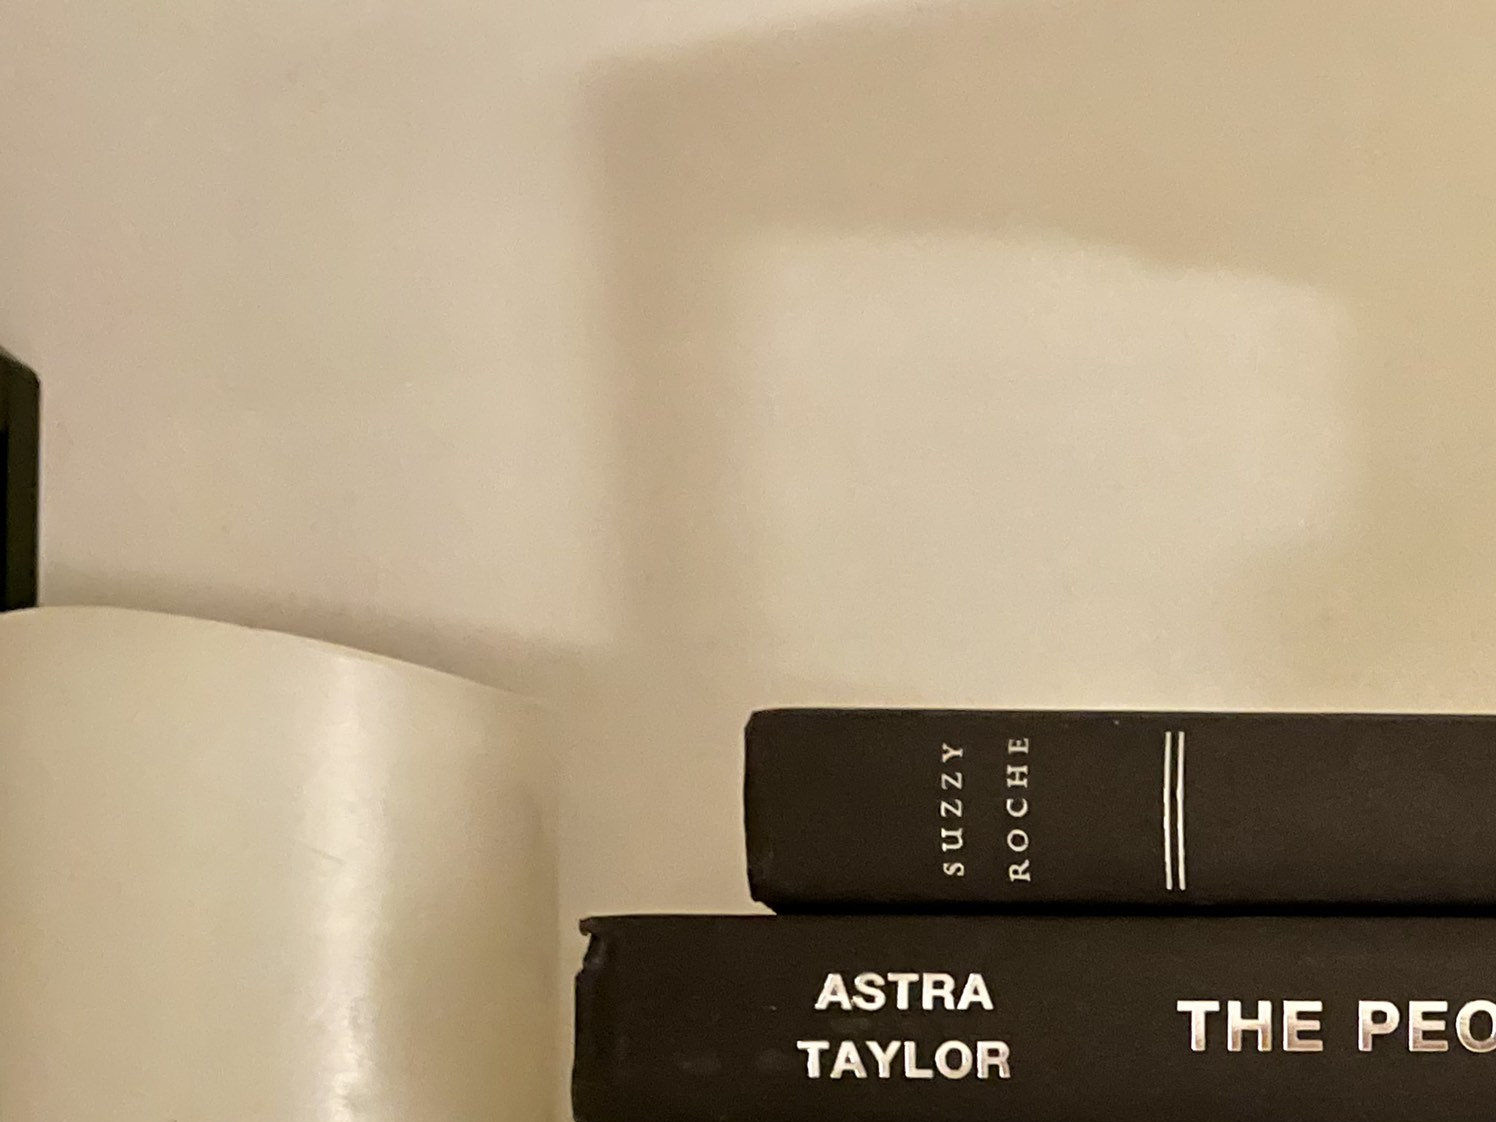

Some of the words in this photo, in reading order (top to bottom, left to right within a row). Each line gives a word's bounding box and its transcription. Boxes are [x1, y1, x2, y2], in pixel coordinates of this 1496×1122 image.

[940, 743, 964, 876] SUZZY
[1006, 738, 1031, 881] ROCHE
[815, 972, 993, 1011] ASTRA
[1177, 1000, 1323, 1052] THE
[797, 1040, 1010, 1079] TAYLOR
